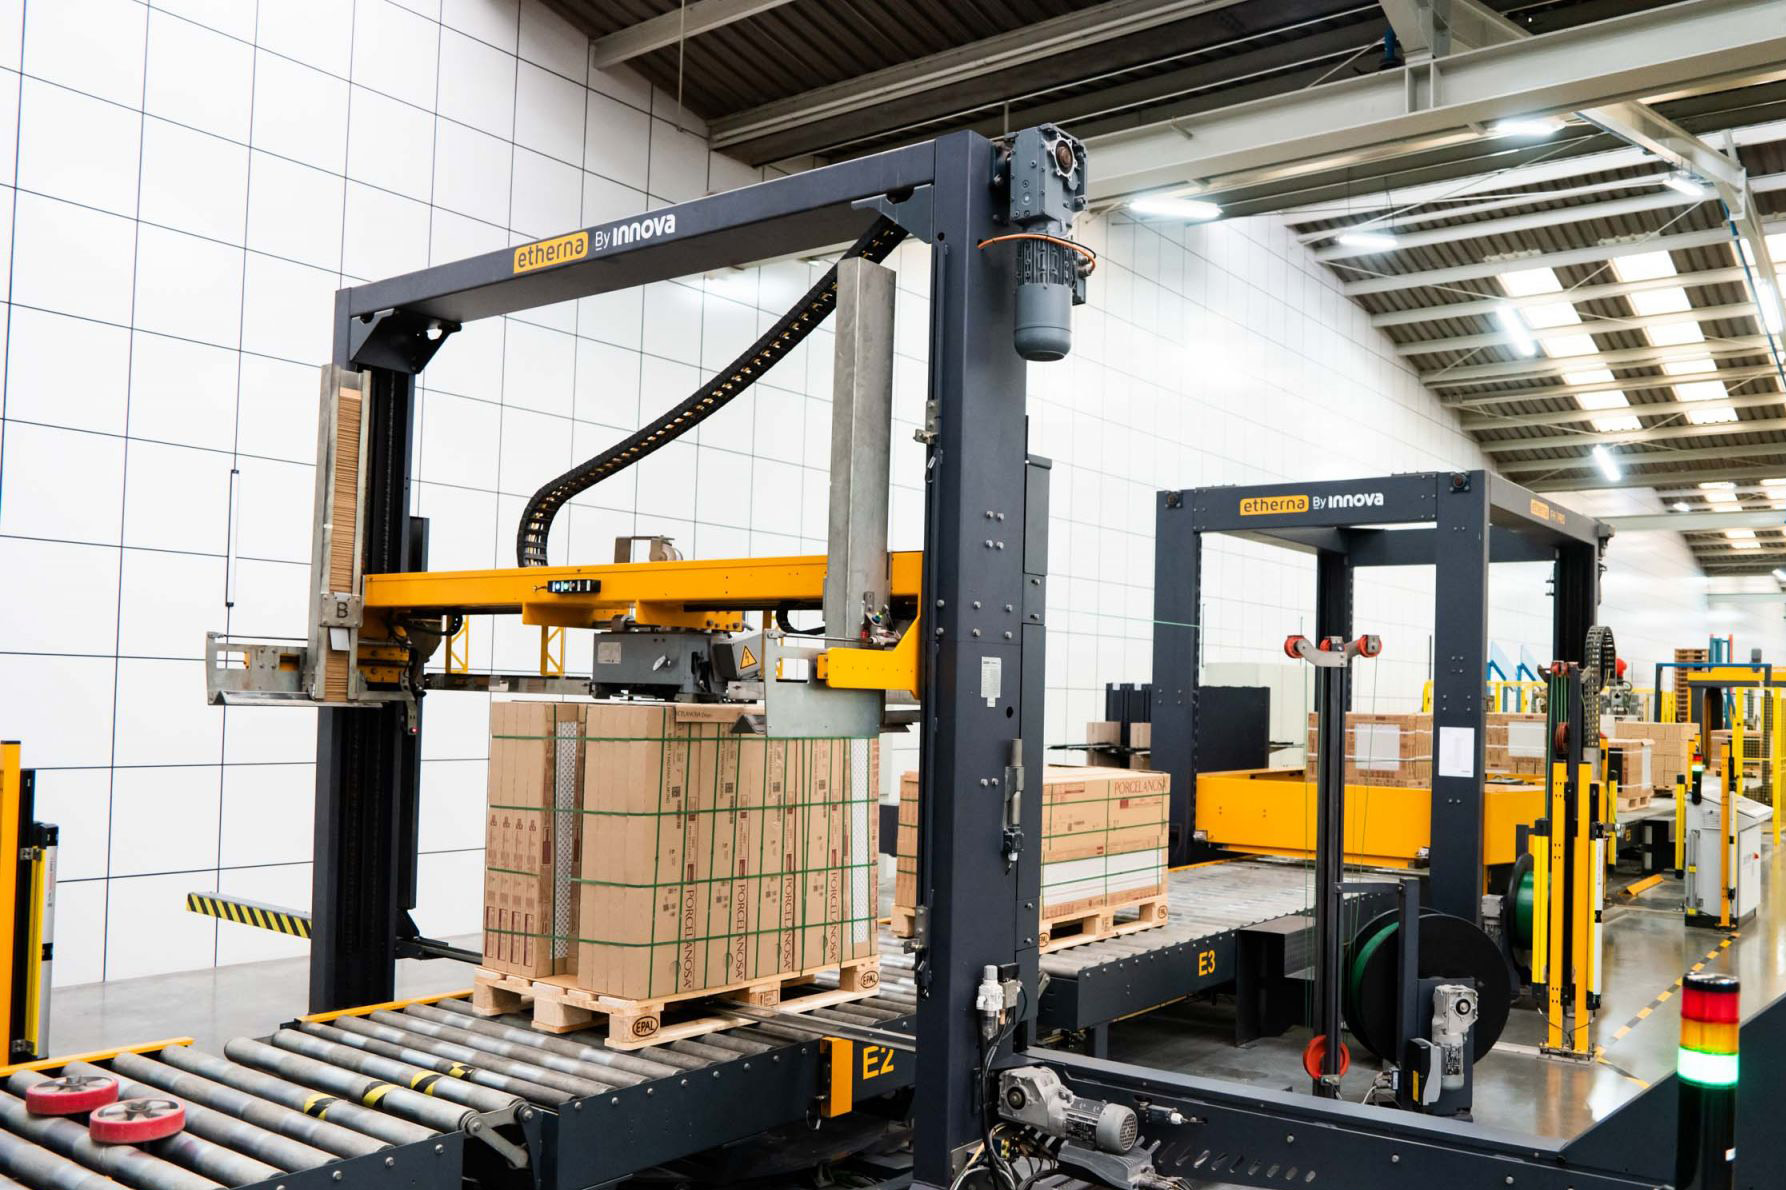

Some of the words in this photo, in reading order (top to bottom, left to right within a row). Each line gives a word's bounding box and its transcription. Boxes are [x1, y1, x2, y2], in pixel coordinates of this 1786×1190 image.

[517, 236, 585, 268] etherna
[595, 230, 611, 251] By
[1243, 498, 1305, 513] etherna
[1312, 496, 1327, 510] By
[336, 602, 349, 618] B
[1199, 950, 1216, 976] E3
[636, 1020, 655, 1033] EPAL
[862, 1045, 895, 1080] E2
